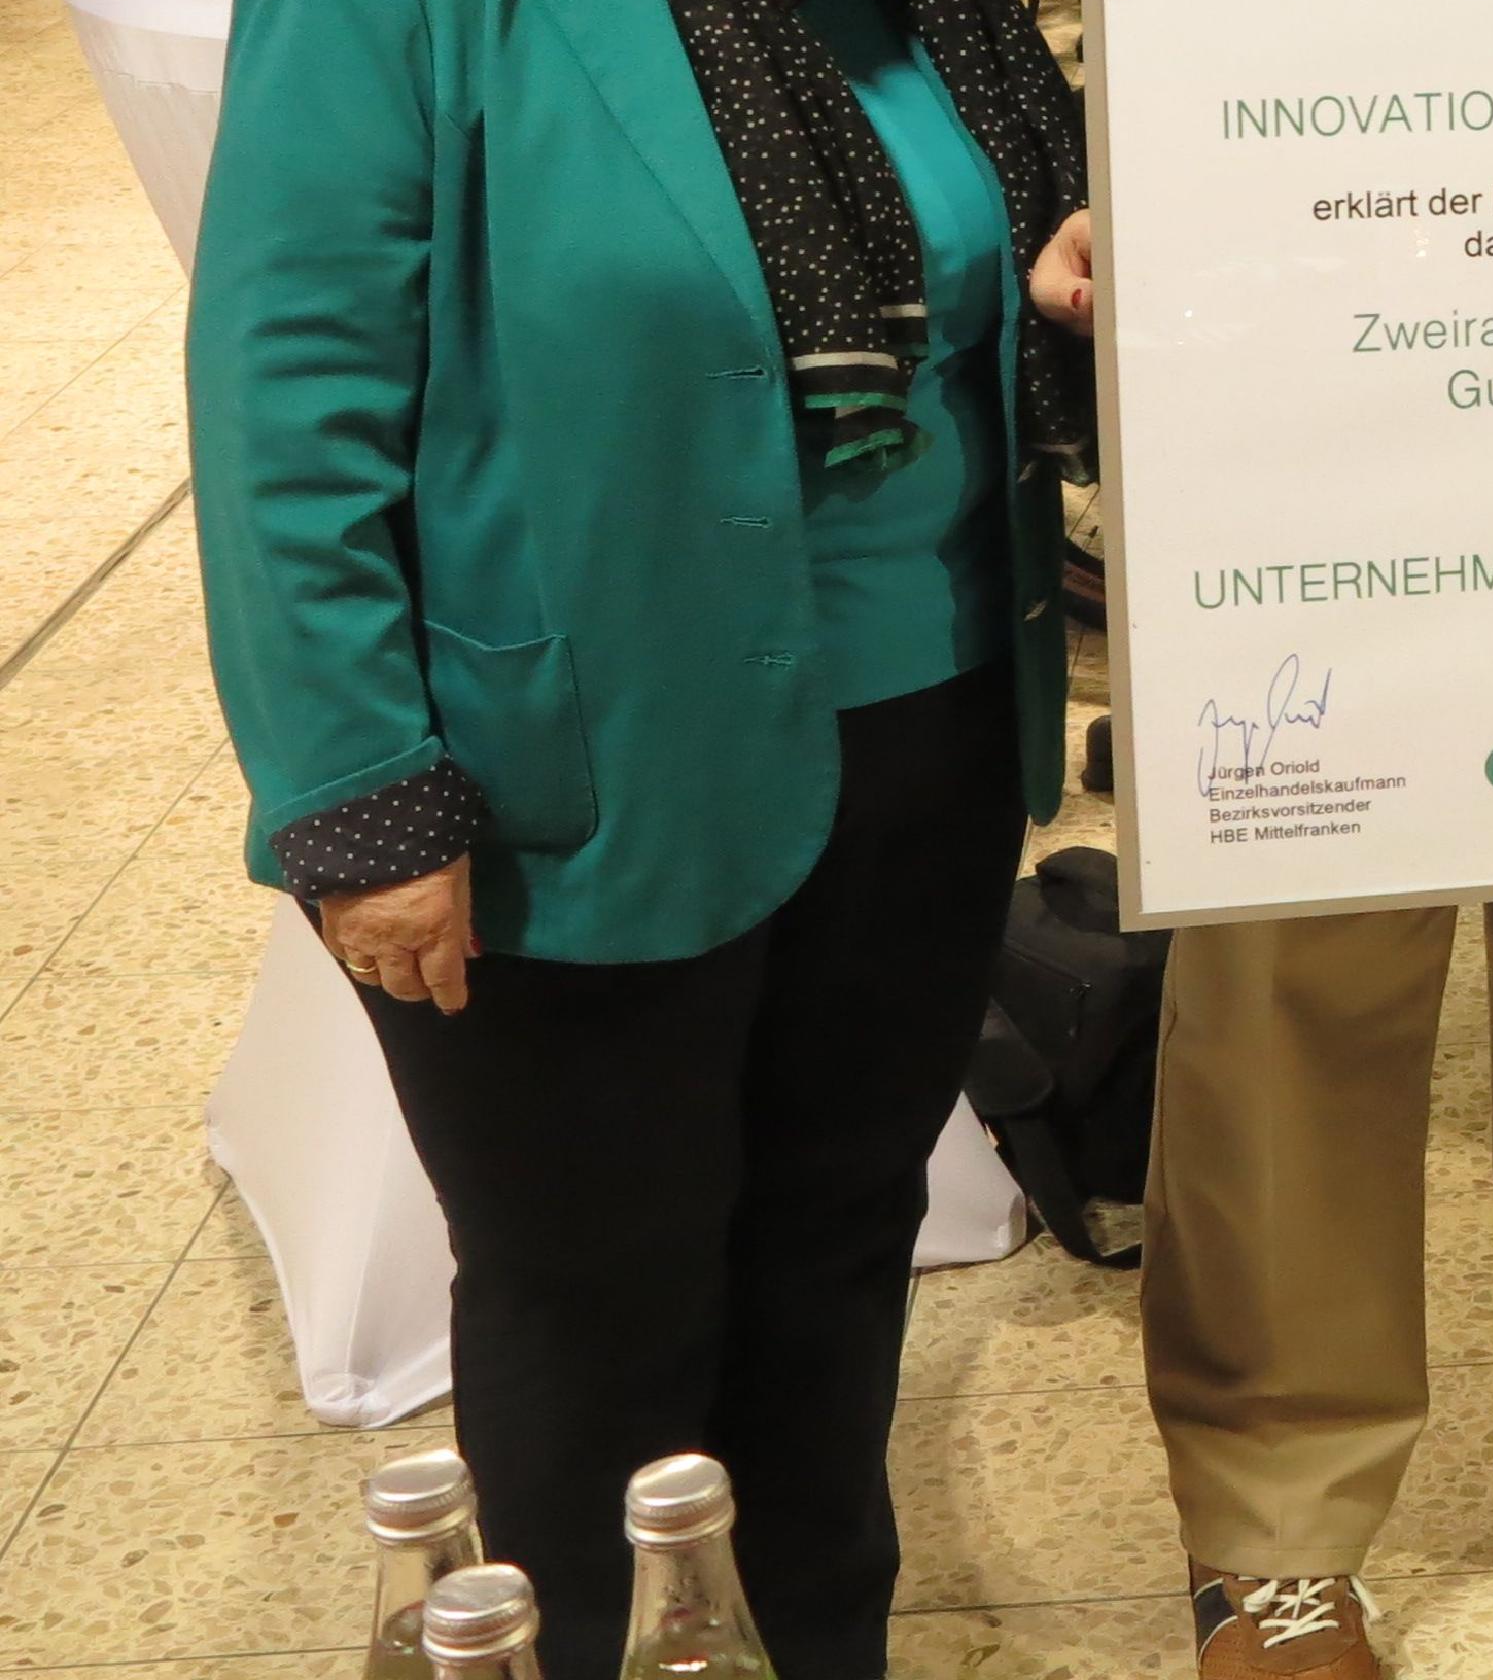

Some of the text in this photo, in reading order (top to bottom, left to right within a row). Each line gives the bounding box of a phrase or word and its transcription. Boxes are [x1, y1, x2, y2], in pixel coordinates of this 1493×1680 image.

[1313, 190, 1419, 221] erklärt
[1428, 187, 1483, 216] der
[1208, 760, 1320, 781] Jürgen Oriold
[1210, 777, 1406, 801] Einzelhandelskaufmann
[1210, 799, 1371, 823] Bezirksvorsitzender
[1211, 821, 1360, 843] HBE Mittelfranken
